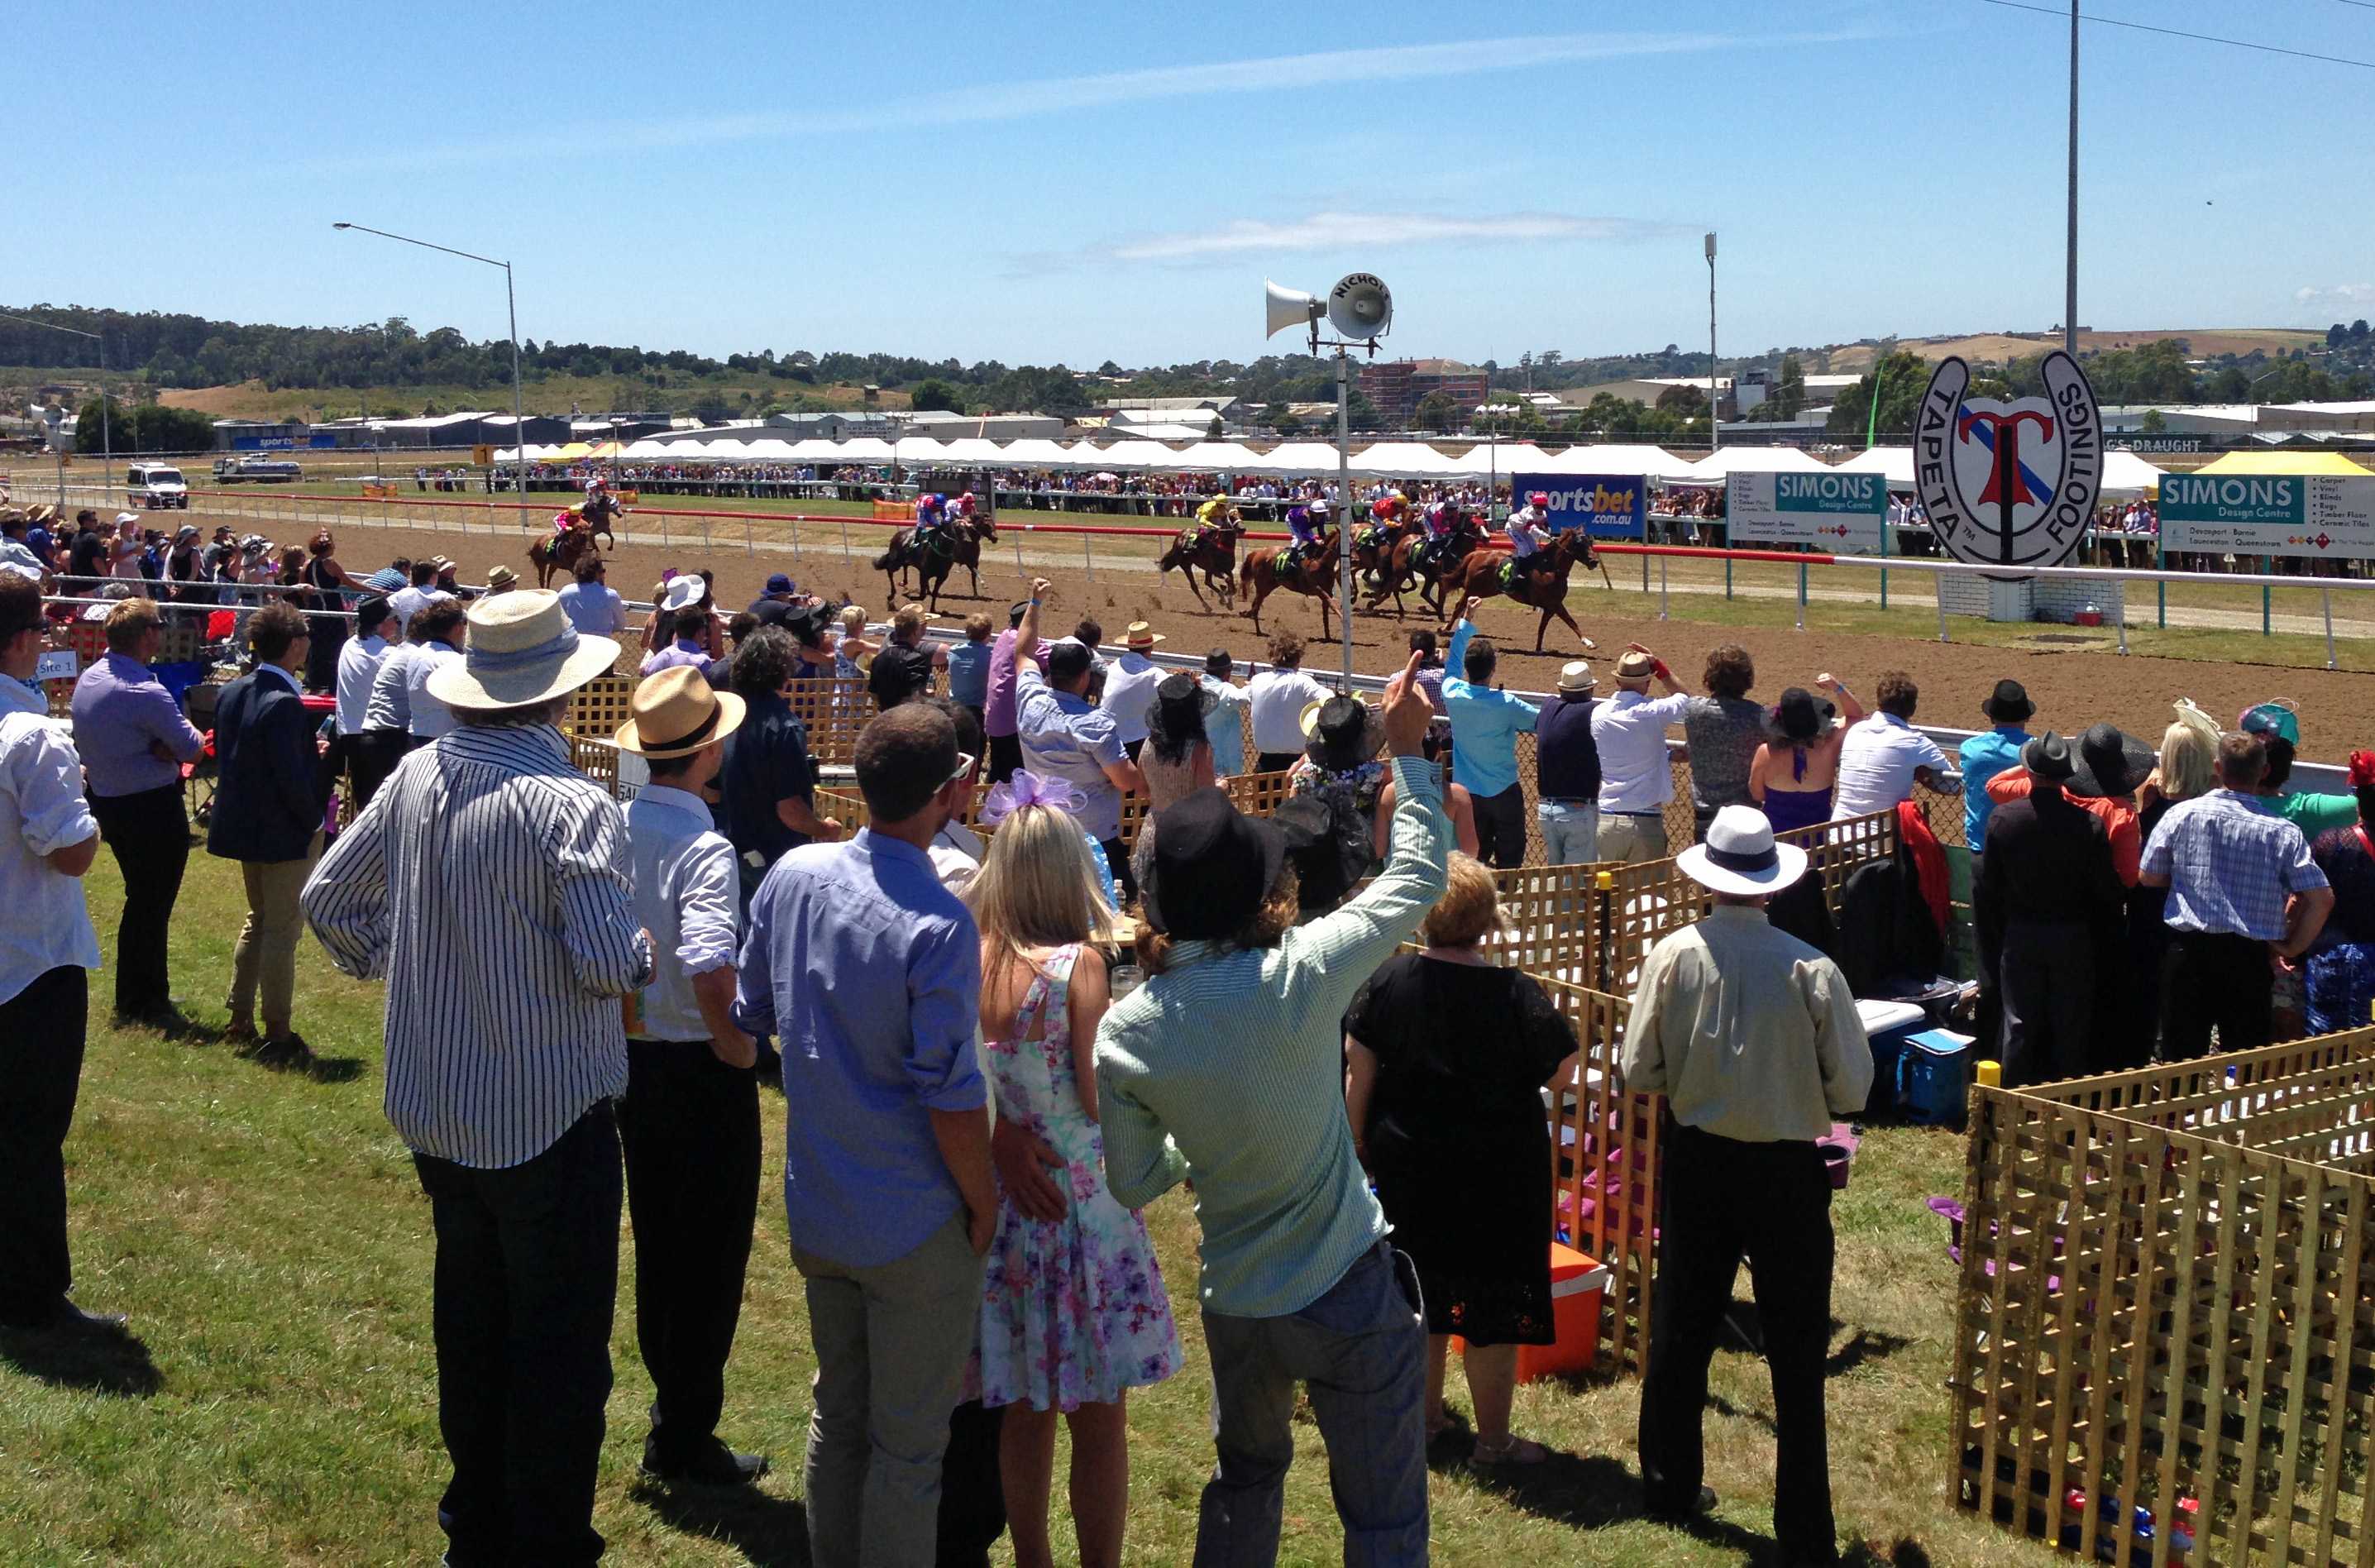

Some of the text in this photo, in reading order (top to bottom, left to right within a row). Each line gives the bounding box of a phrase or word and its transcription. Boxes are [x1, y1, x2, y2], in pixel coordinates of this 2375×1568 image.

[2134, 439, 2201, 452] DRAUGHT
[480, 447, 487, 463] 1
[1921, 390, 1960, 540] TAPETA
[2046, 383, 2094, 546] FOOTINGS
[2320, 477, 2346, 485] Carpet
[1780, 476, 1873, 499] SIMONS
[2165, 479, 2292, 506] SIMONS
[1522, 484, 1634, 514] sortsbet
[1819, 500, 1872, 510] Design Centre
[2320, 502, 2338, 510] Rugs
[2219, 507, 2291, 519] Design Centre
[1592, 514, 1632, 525] .com.au
[2189, 527, 2227, 536] Devonport
[2235, 538, 2282, 548] Queenstown
[40, 662, 72, 673] Site 1
